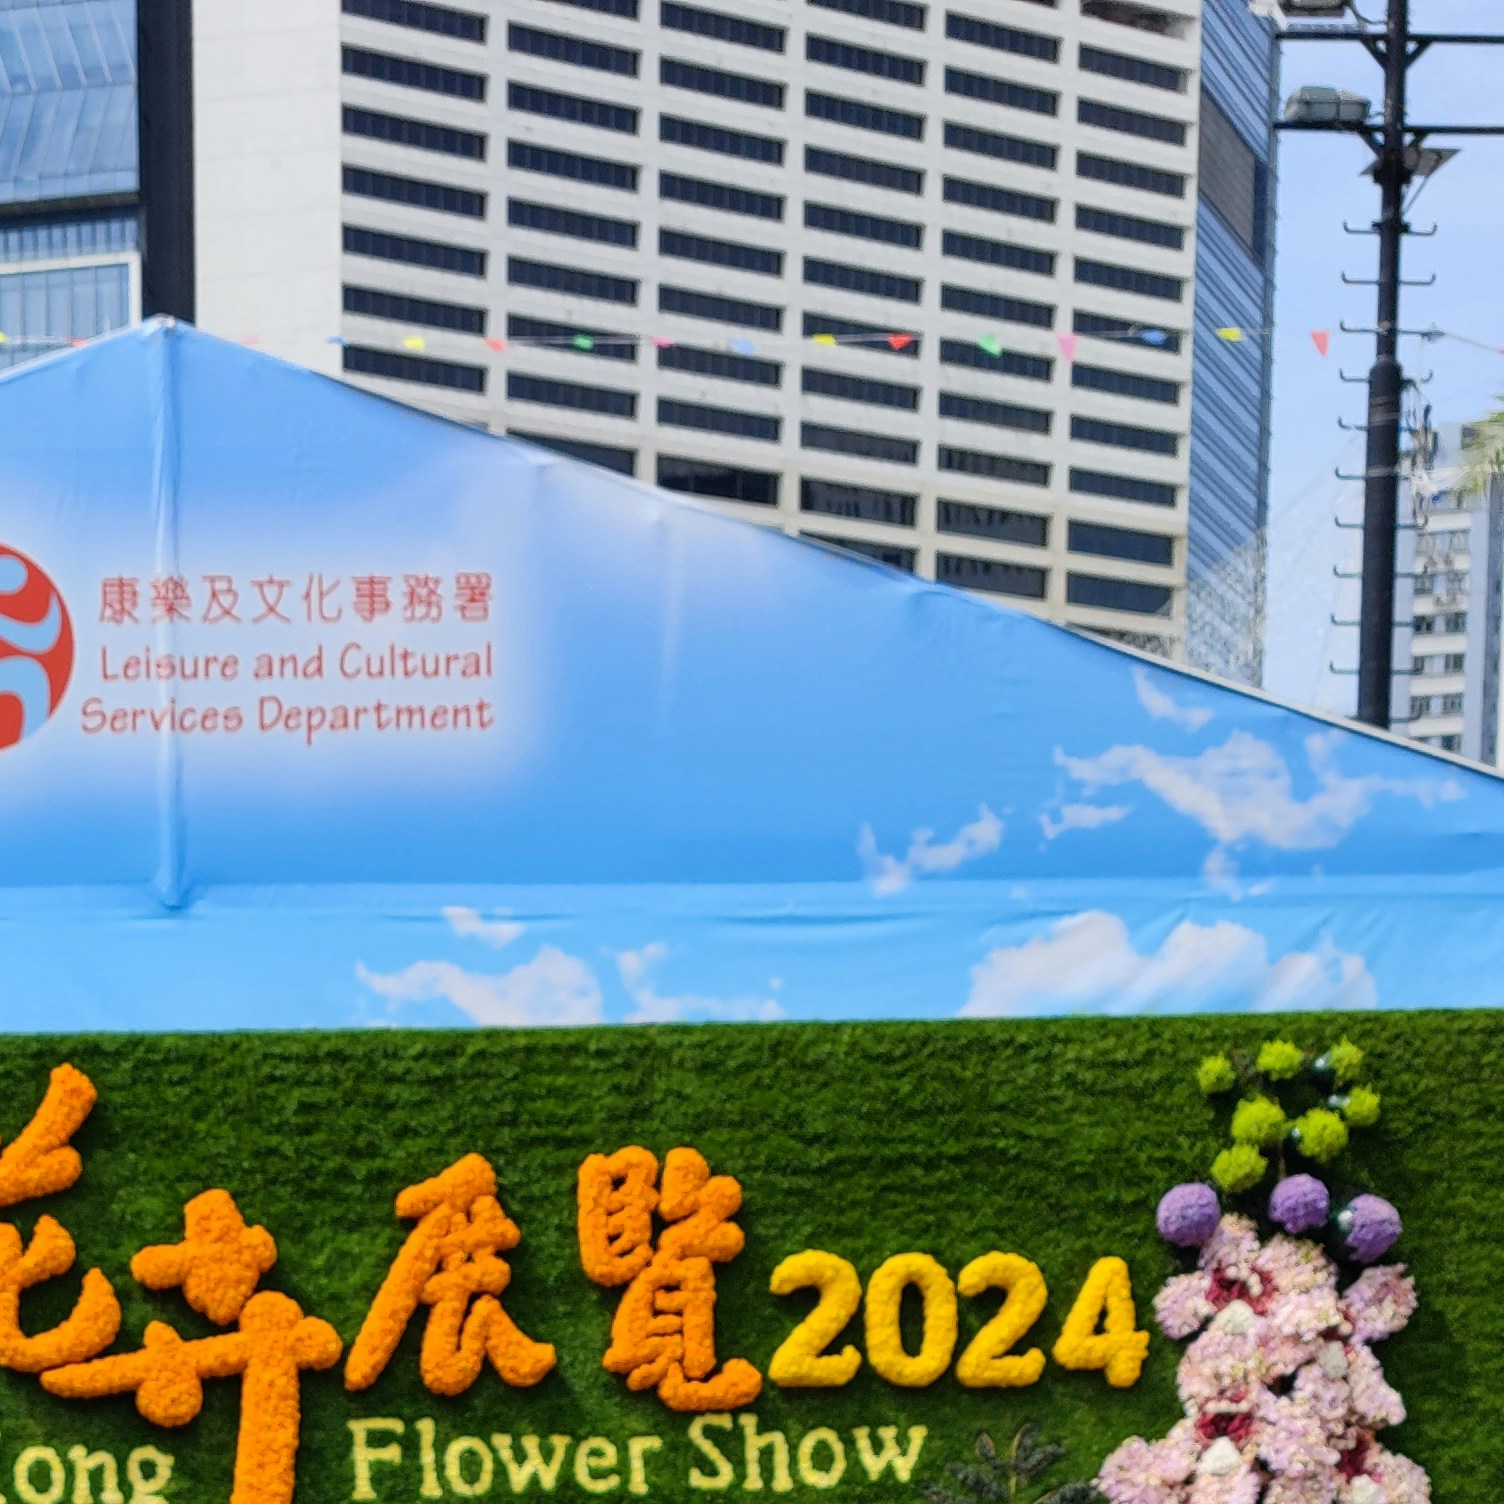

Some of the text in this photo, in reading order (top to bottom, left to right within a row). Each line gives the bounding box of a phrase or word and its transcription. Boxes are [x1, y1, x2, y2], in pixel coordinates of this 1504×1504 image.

[97, 571, 493, 625] 康樂及文化事務署
[98, 640, 494, 684] Leisure and Cultural
[78, 696, 494, 746] Services Department
[768, 1248, 1150, 1385] 2024
[348, 1417, 663, 1500] Flower
[688, 1415, 928, 1494] Show
